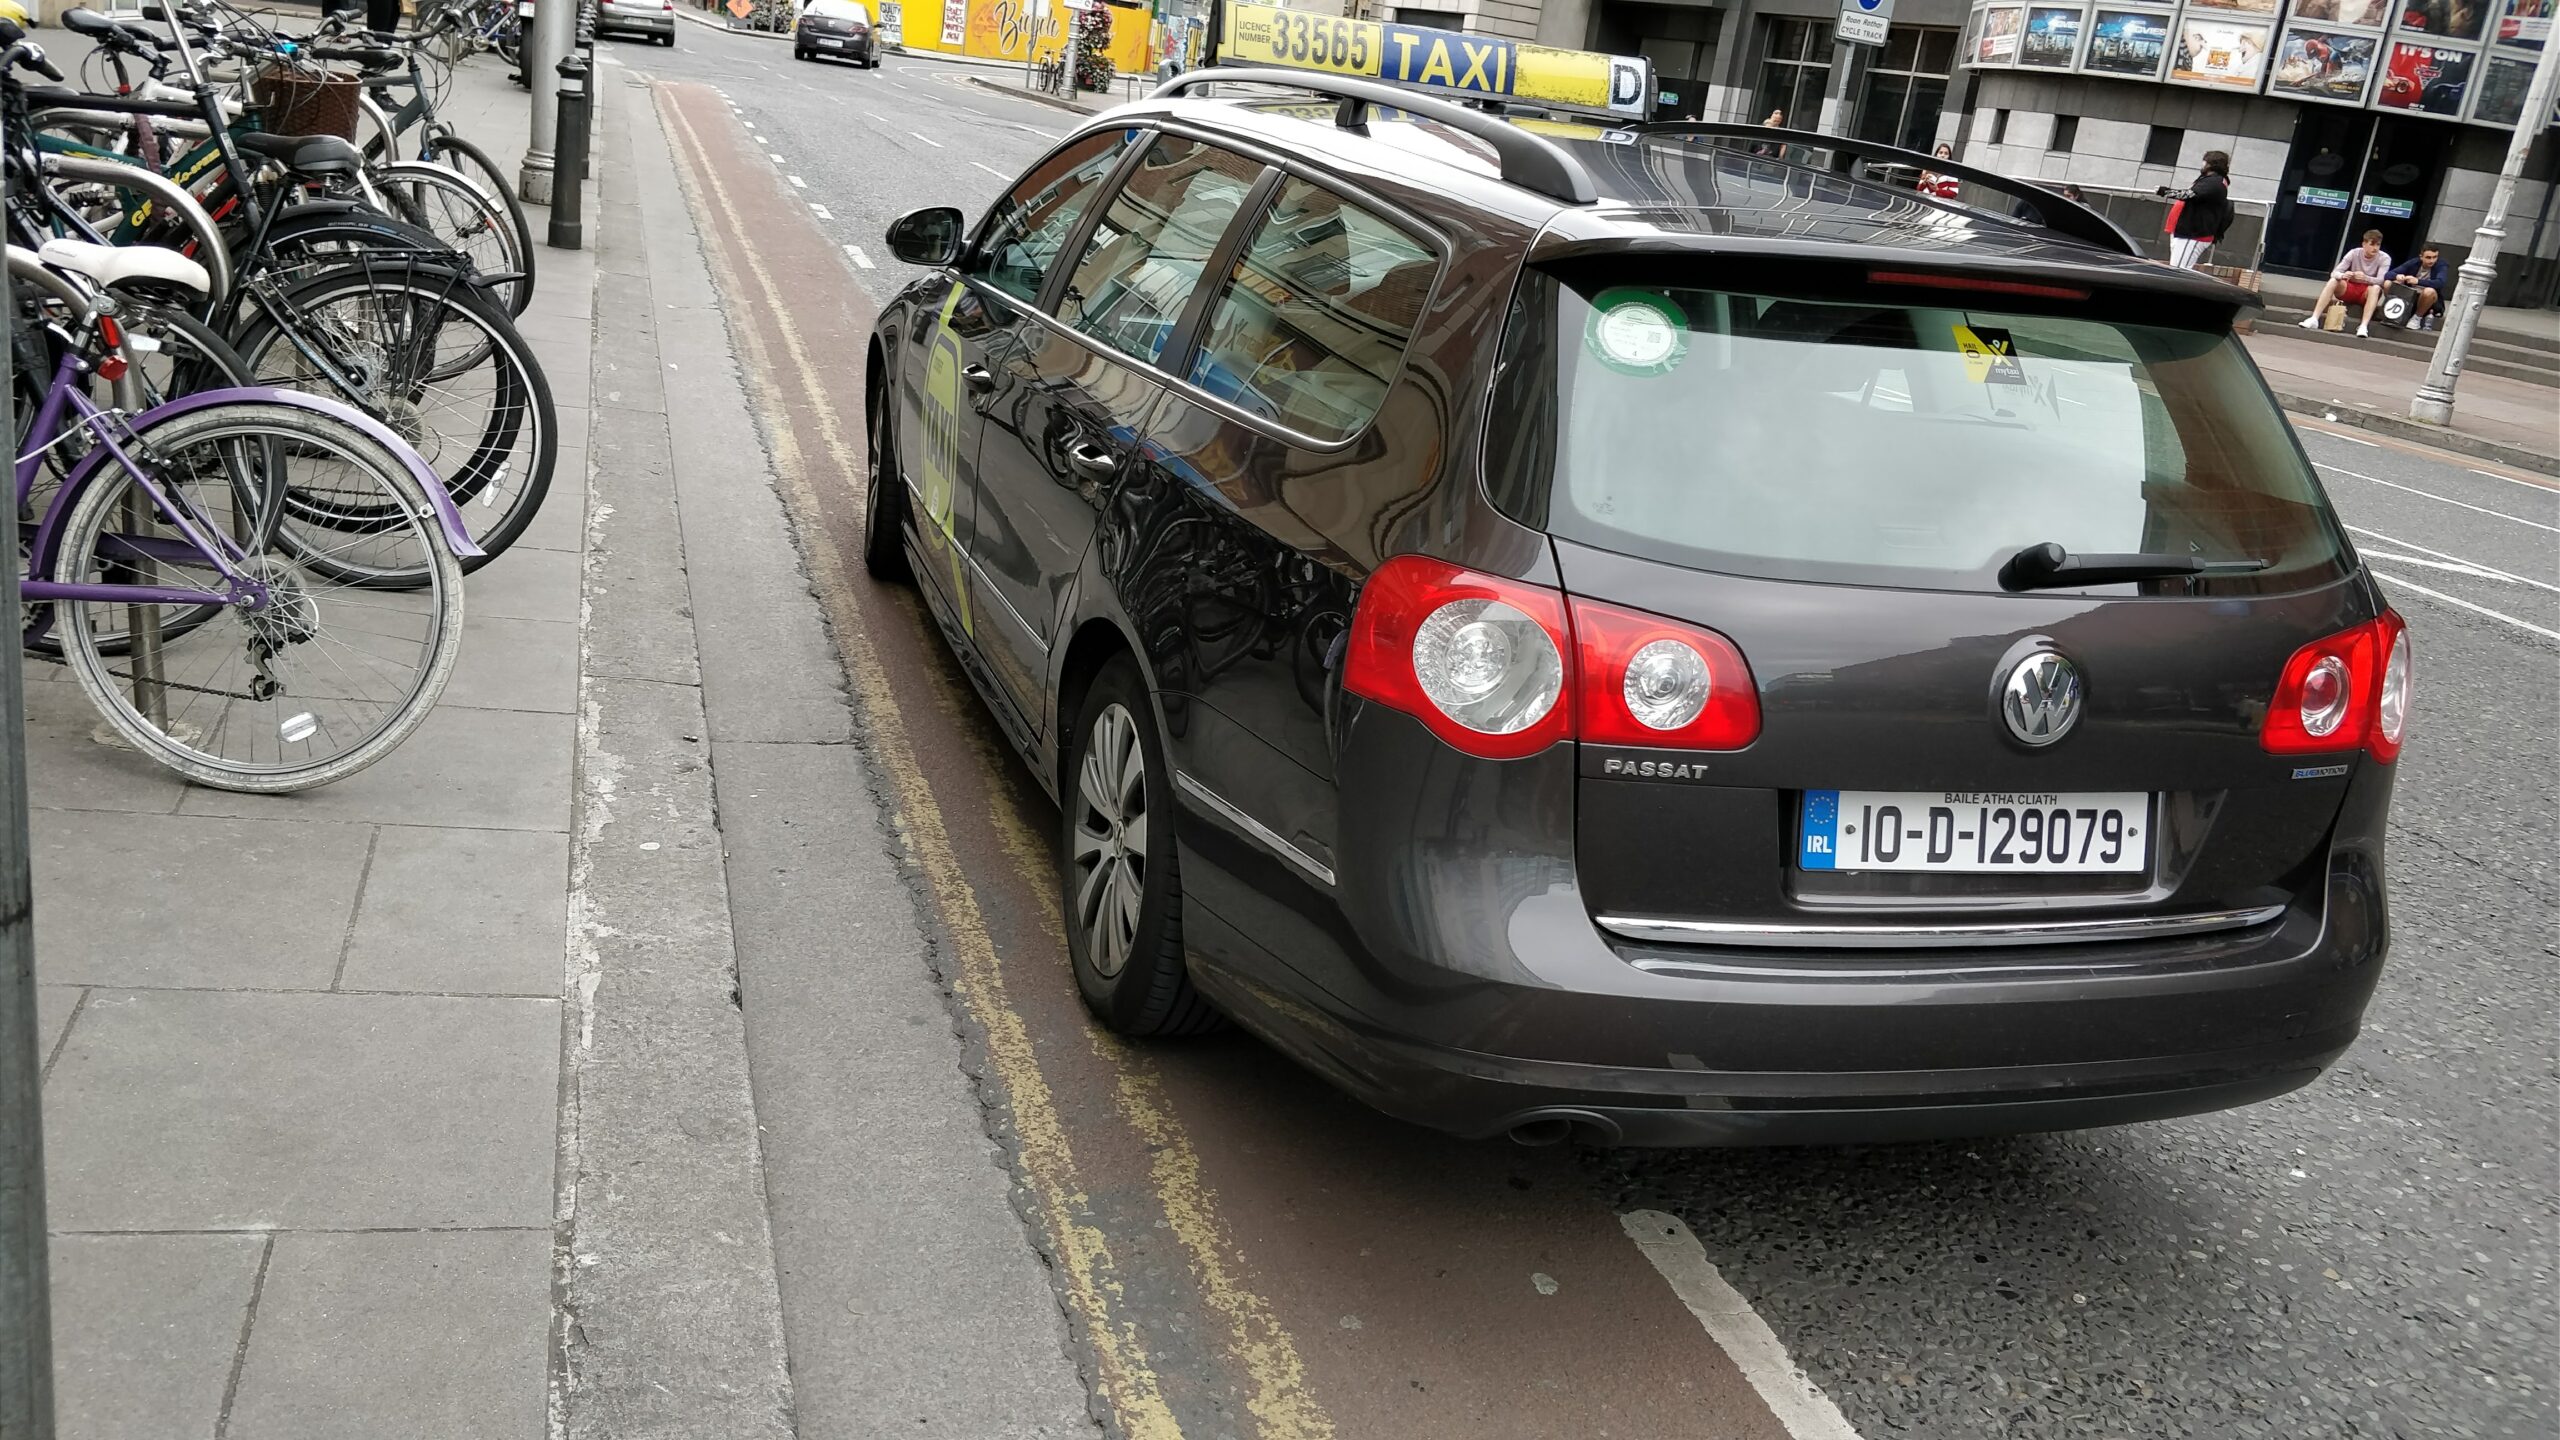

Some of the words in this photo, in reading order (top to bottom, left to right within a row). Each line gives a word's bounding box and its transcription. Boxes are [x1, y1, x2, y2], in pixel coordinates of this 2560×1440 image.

[1239, 21, 1271, 33] LICENCE
[1841, 26, 1860, 36] CYCLE
[1863, 30, 1883, 40] TRACK
[1238, 32, 1271, 44] NUMBER
[1272, 11, 1367, 70] 33565
[1393, 32, 1507, 93] TAXI
[2400, 44, 2432, 58] IT'S
[2434, 49, 2463, 63] ON
[1612, 64, 1643, 106] D
[2386, 303, 2402, 314] JD
[1604, 758, 1709, 780] PASSAT
[1944, 793, 1979, 804] BAILE
[1983, 793, 2014, 804] ATHA
[2018, 794, 2058, 805] CLIATH
[1807, 835, 1832, 853] IRL
[1860, 805, 2124, 865] 10-D-129079
